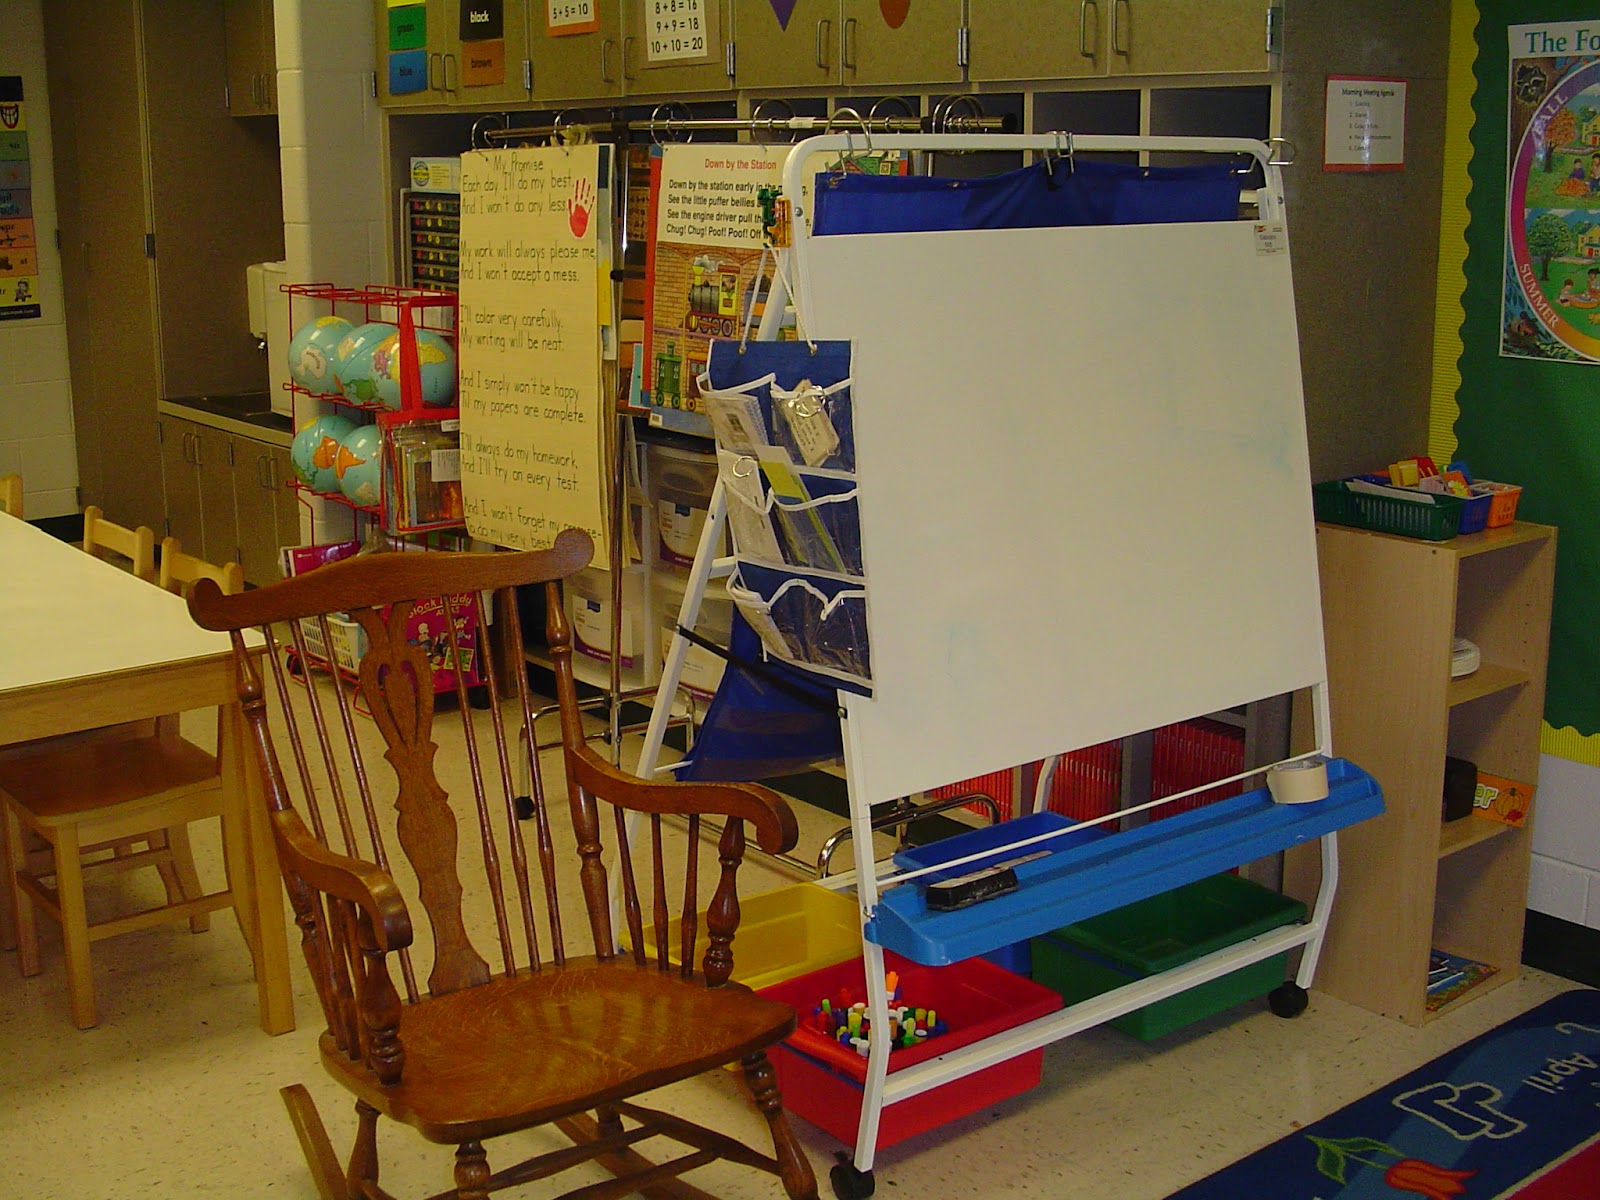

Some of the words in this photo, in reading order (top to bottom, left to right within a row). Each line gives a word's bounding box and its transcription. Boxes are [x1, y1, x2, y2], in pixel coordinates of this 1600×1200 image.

[470, 10, 489, 23] black
[553, 7, 558, 19] 5
[565, 5, 569, 17] 5
[578, 3, 588, 15] 10
[655, 2, 661, 14] 8
[671, 0, 676, 12] 8
[687, 0, 697, 10] 16
[397, 24, 414, 36] green
[656, 21, 661, 33] 9
[671, 20, 677, 32] 9
[688, 17, 699, 29] 18
[651, 41, 661, 53] 10
[671, 39, 681, 51] 10
[692, 37, 703, 49] 20
[1524, 31, 1567, 53] The
[1575, 29, 1600, 51] Fo
[400, 66, 413, 76] blue
[471, 58, 492, 68] brown
[1531, 93, 1568, 139] FALL
[493, 155, 506, 173] My
[511, 152, 544, 172] Promise
[705, 159, 725, 169] Down
[726, 159, 735, 171] by
[737, 159, 749, 170] the
[751, 160, 777, 170] Station
[462, 174, 481, 193] Each
[484, 173, 498, 196] day
[518, 172, 528, 190] do
[531, 177, 544, 194] my
[669, 179, 687, 189] Down
[689, 180, 696, 191] by
[698, 180, 708, 190] the
[710, 181, 734, 191] station
[735, 182, 754, 194] early
[461, 194, 476, 214] And
[487, 195, 510, 213] won't
[514, 194, 524, 213] do
[528, 201, 544, 217] any
[668, 194, 680, 204] See
[681, 195, 692, 205] the
[693, 195, 707, 205] little
[709, 197, 729, 207] puffer
[731, 197, 755, 208] bellies
[667, 209, 679, 219] See
[681, 210, 691, 220] the
[693, 211, 714, 222] engine
[716, 211, 737, 222] driver
[738, 214, 752, 224] pull
[754, 214, 763, 224] th
[666, 223, 686, 236] Chug!
[688, 225, 707, 238] Chug!
[708, 226, 727, 237] Poof!
[728, 227, 748, 239] Poof!
[474, 240, 493, 258] work
[497, 240, 512, 258] will
[515, 241, 545, 262] always
[550, 240, 579, 264] please
[460, 262, 473, 280] And
[485, 263, 508, 280] won't
[512, 263, 541, 286] accept
[544, 270, 550, 282] a
[1519, 263, 1559, 328] SUMMER
[475, 306, 495, 324] color
[498, 313, 517, 331] very
[477, 330, 505, 352] writing
[510, 330, 523, 348] will
[528, 332, 538, 349] be
[460, 369, 473, 388] And
[485, 374, 509, 396] simply
[515, 376, 537, 395] won't
[540, 377, 550, 395] be
[554, 376, 579, 403] happy
[474, 399, 486, 416] my
[491, 401, 518, 418] papers
[524, 405, 539, 418] are
[476, 435, 500, 459] always
[504, 440, 514, 458] do
[516, 448, 529, 464] my
[462, 454, 475, 472] And
[495, 460, 508, 483] try
[512, 470, 522, 481] on
[527, 473, 551, 491] every
[464, 496, 478, 515] And
[491, 504, 513, 521] won't
[517, 507, 546, 533] forget
[549, 519, 560, 533] my
[490, 528, 503, 543] my
[507, 533, 526, 549] very
[1522, 1052, 1598, 1094] April
